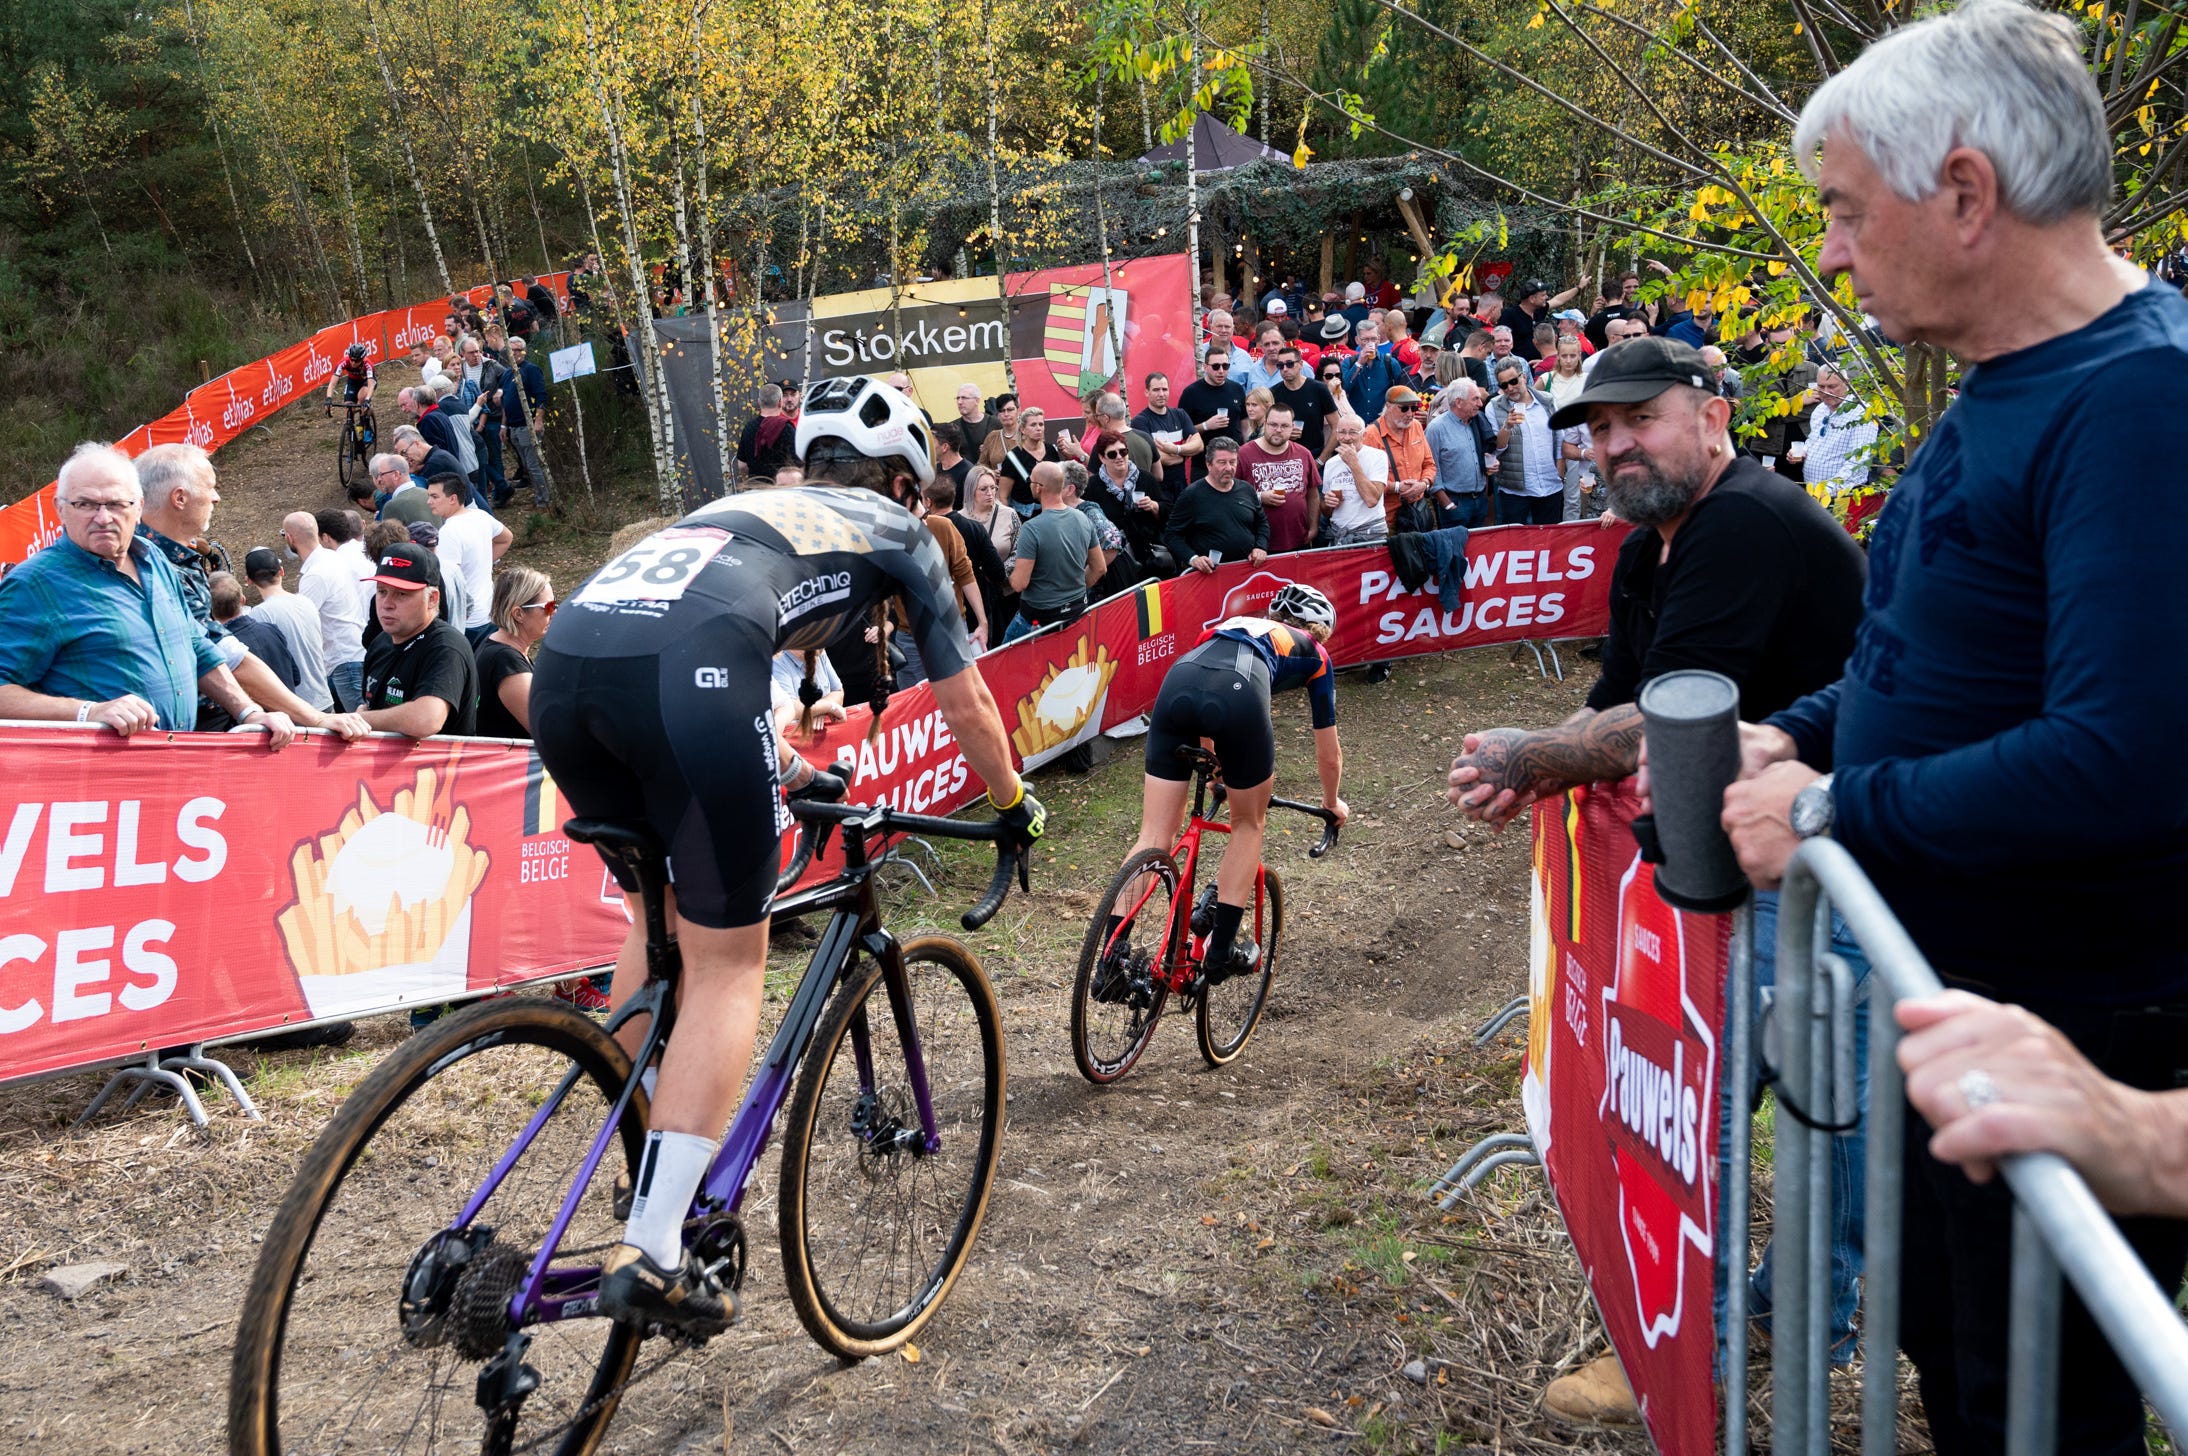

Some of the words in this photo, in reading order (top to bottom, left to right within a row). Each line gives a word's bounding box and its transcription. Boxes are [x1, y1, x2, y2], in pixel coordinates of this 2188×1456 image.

[344, 321, 378, 358] ehas
[395, 308, 435, 349] ethias
[824, 318, 1004, 367] Stokkem
[263, 358, 293, 408] ethias
[303, 341, 333, 385] ethias
[223, 378, 255, 431] ethias
[27, 493, 65, 559] ethi
[596, 547, 702, 585] 58
[1359, 545, 1596, 605] PAWELS
[798, 595, 824, 614] BIKE
[1246, 590, 1275, 601] SAUCES
[1375, 592, 1566, 645] SAUCES
[1137, 642, 1175, 666] BELGE
[1138, 633, 1175, 652] BELGISCH
[837, 709, 958, 787] PAUWE
[844, 752, 968, 813] UCES
[521, 839, 570, 858] BELGISCH
[521, 855, 569, 883] BELGE
[1634, 922, 1662, 965] SAUCES
[1565, 982, 1588, 1047] BELGE
[1609, 1016, 1698, 1185] Pauwels
